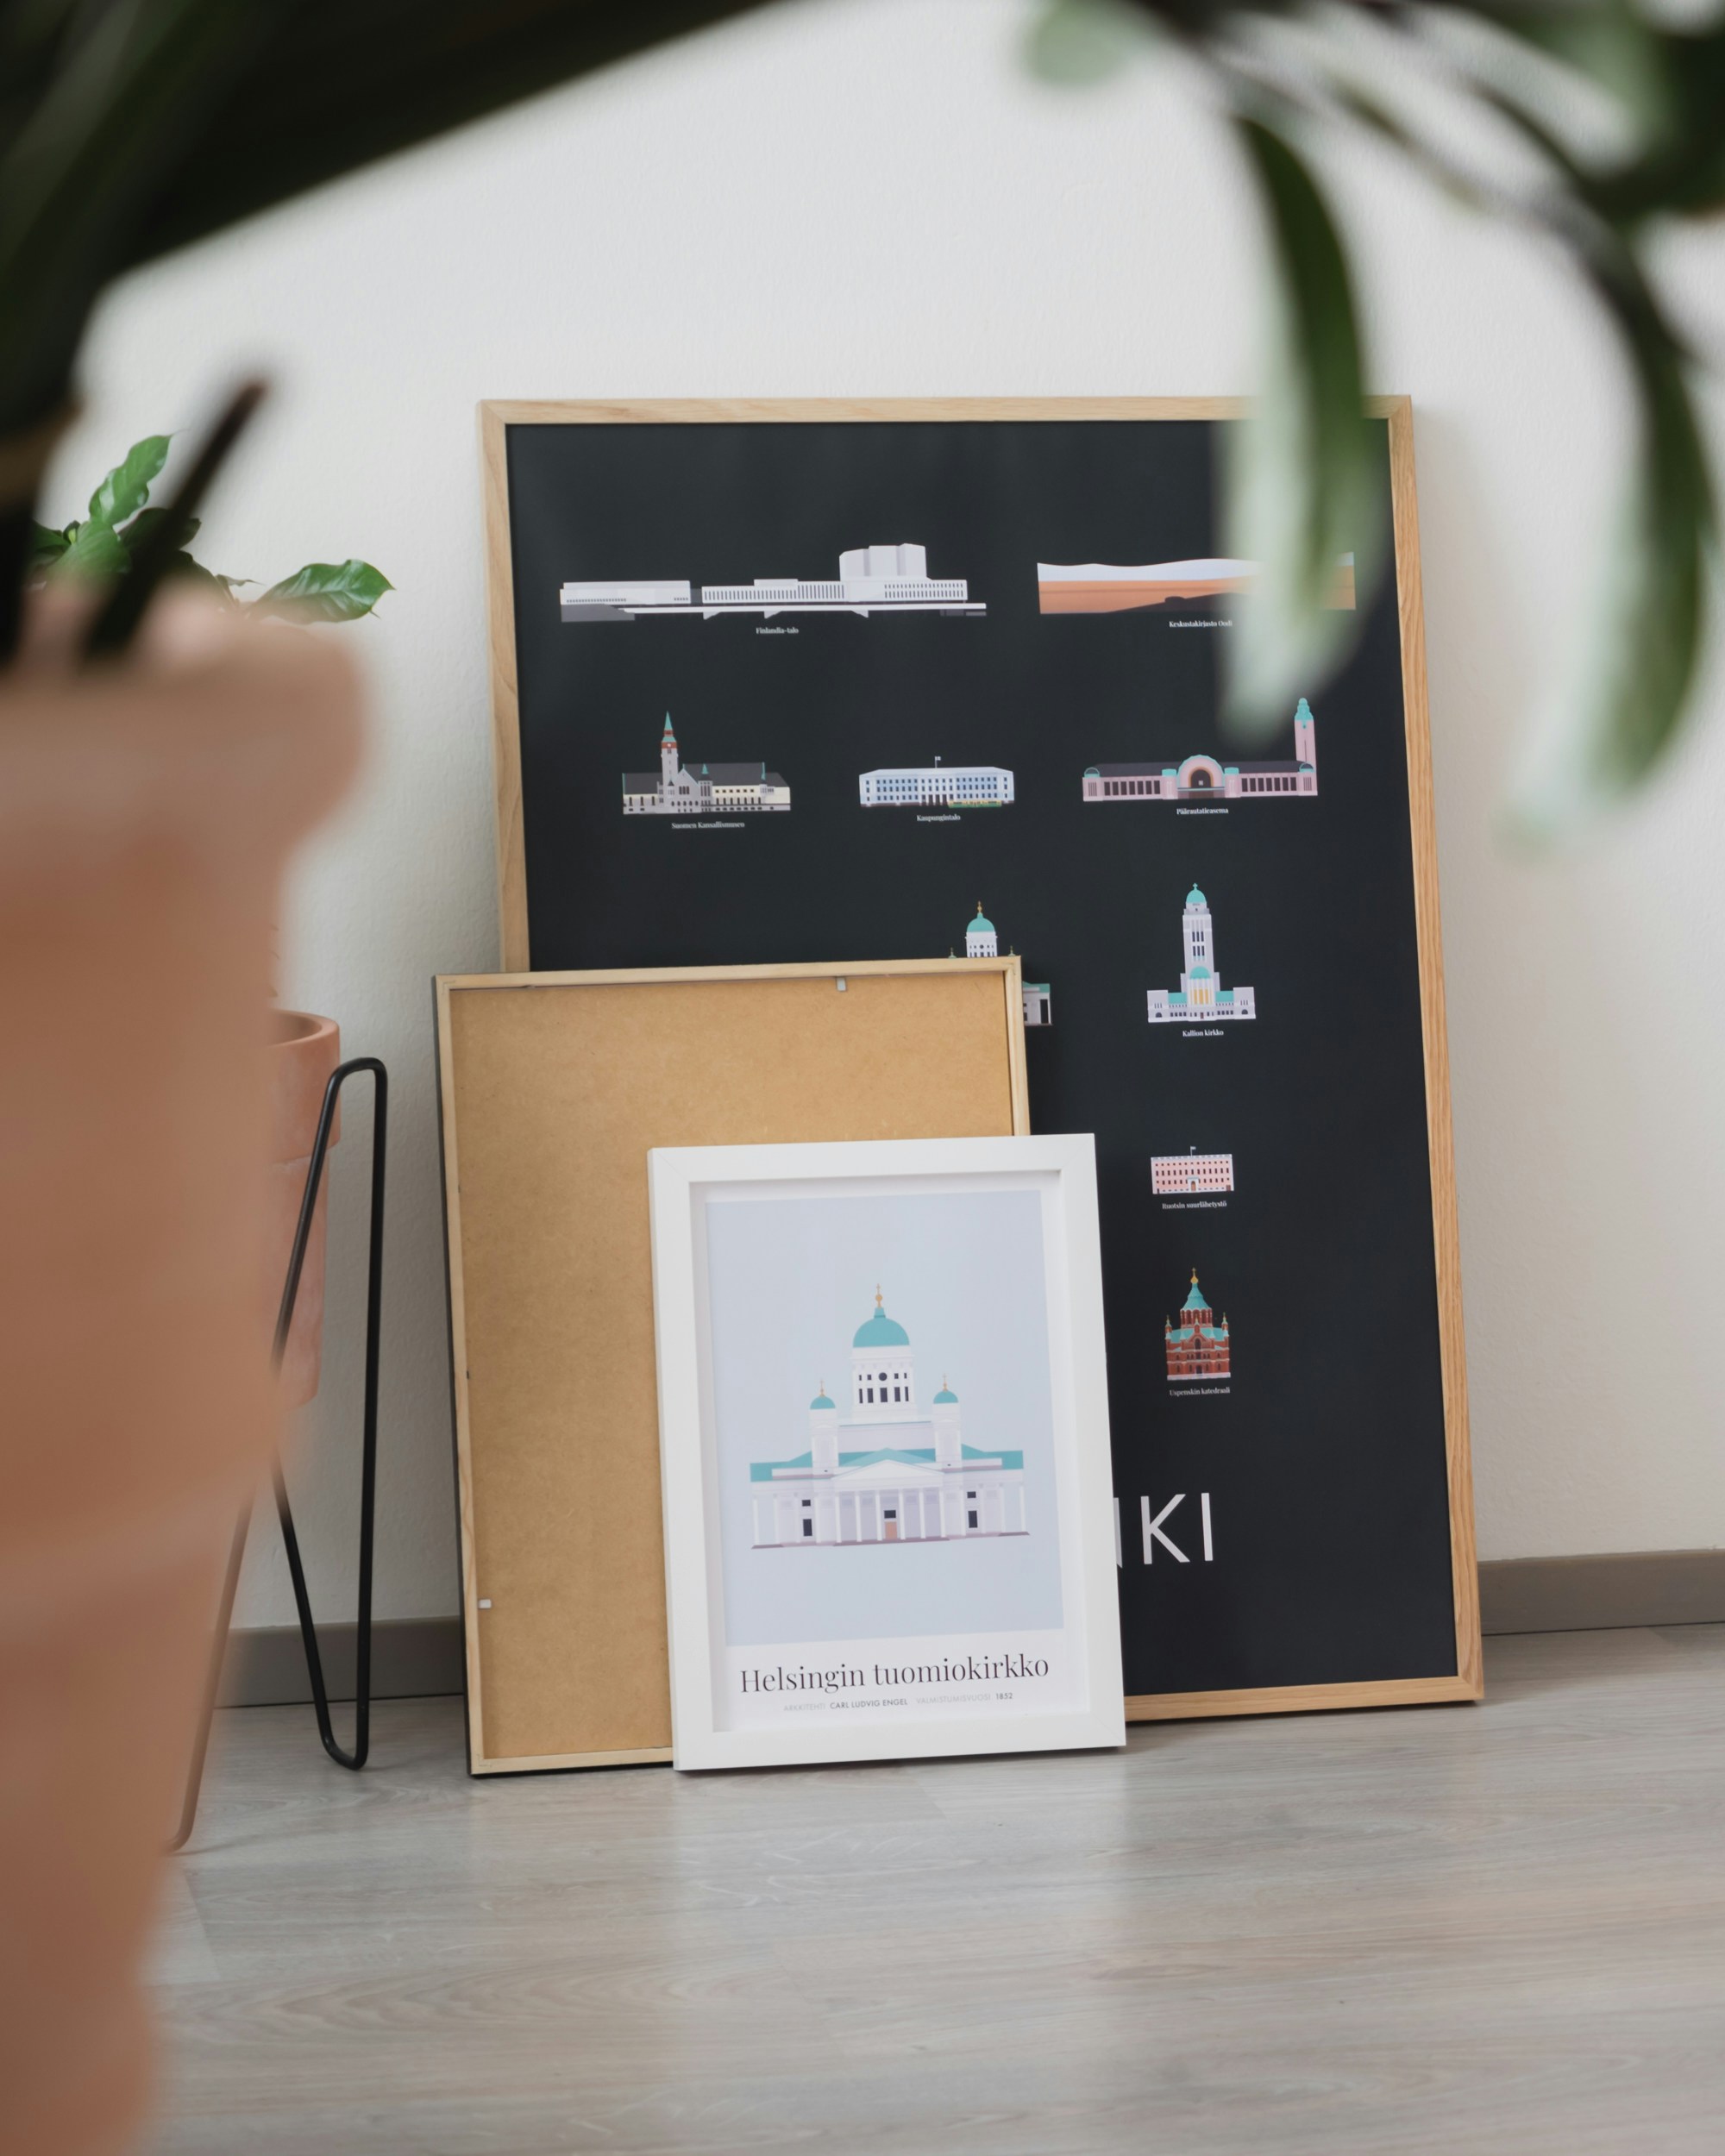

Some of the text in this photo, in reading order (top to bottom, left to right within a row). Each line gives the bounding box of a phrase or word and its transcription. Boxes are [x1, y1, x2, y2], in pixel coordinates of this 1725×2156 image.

[916, 813, 961, 823] Kaupungintalo
[1186, 1200, 1227, 1209] suurlähetystö
[1170, 1388, 1201, 1397] Uspenskin
[740, 1653, 1050, 1694] Helsingin tuomiokirkko
[783, 1692, 1013, 1711] ARKKITEHTI CARL LUDVIG ENGEL VALMISTUMISVUOSI 1852
